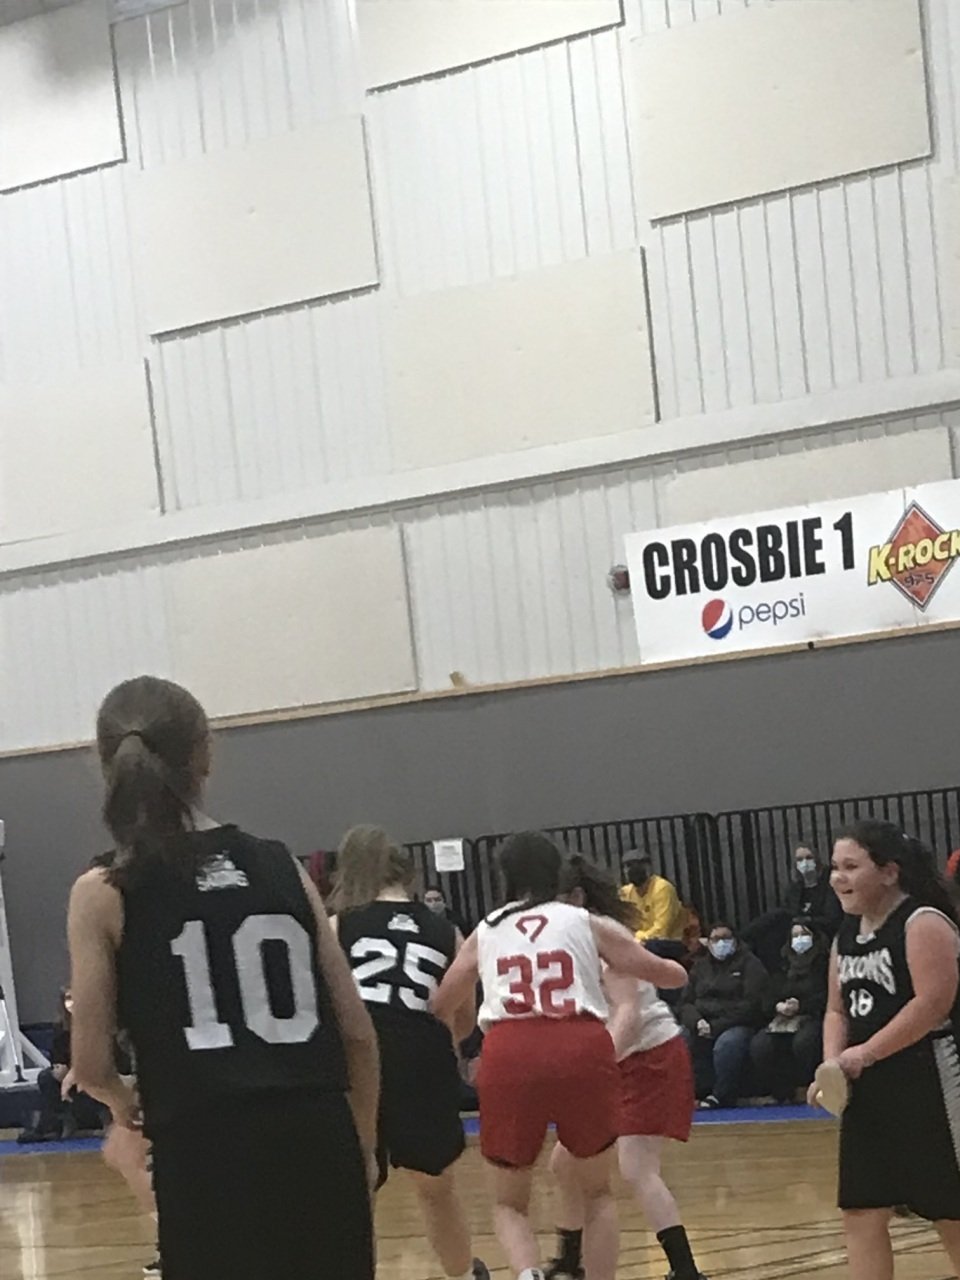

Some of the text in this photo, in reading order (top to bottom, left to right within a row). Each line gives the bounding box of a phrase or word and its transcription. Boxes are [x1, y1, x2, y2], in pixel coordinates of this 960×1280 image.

[642, 511, 855, 600] CROSBIE 1
[738, 592, 806, 630] pepsi
[169, 914, 320, 1050] 10
[351, 937, 449, 1011] 25
[497, 949, 577, 1019] 32
